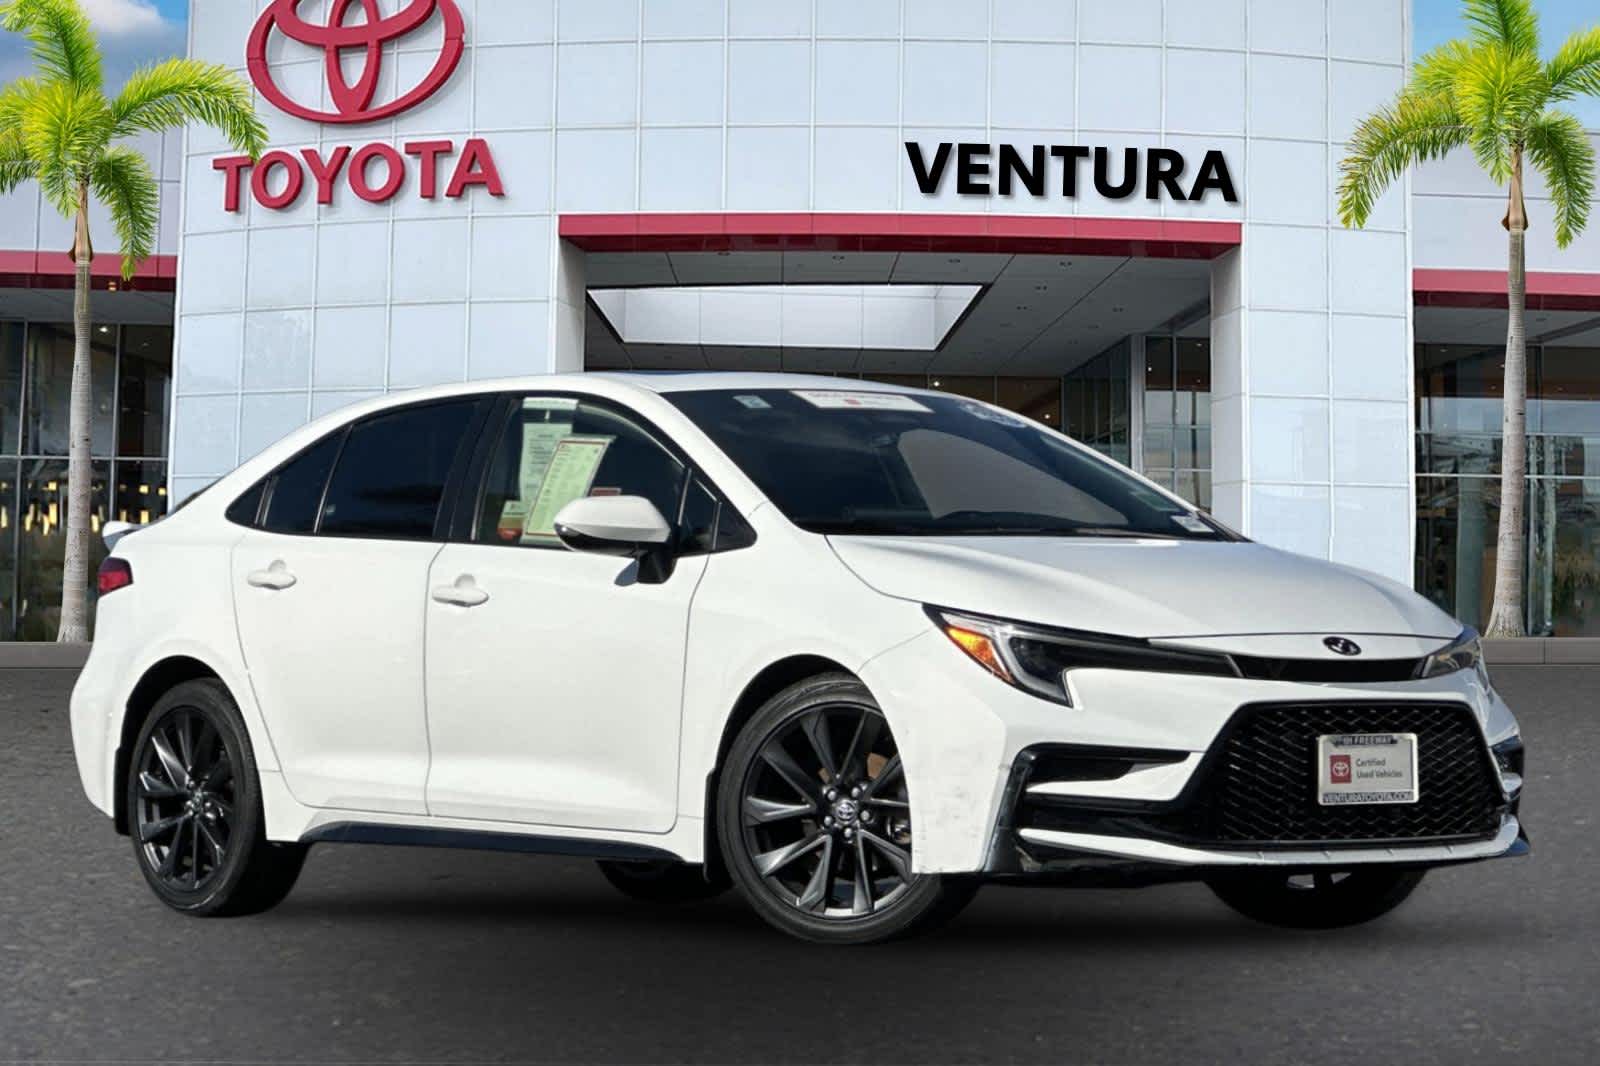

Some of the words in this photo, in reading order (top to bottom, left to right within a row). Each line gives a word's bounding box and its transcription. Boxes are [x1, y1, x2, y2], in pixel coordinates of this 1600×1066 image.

[213, 138, 505, 212] TOYOTA
[904, 141, 1237, 202] VENTURA
[1355, 757, 1386, 767] Certified
[1356, 769, 1374, 778] Used
[1375, 769, 1403, 778] Vehicles
